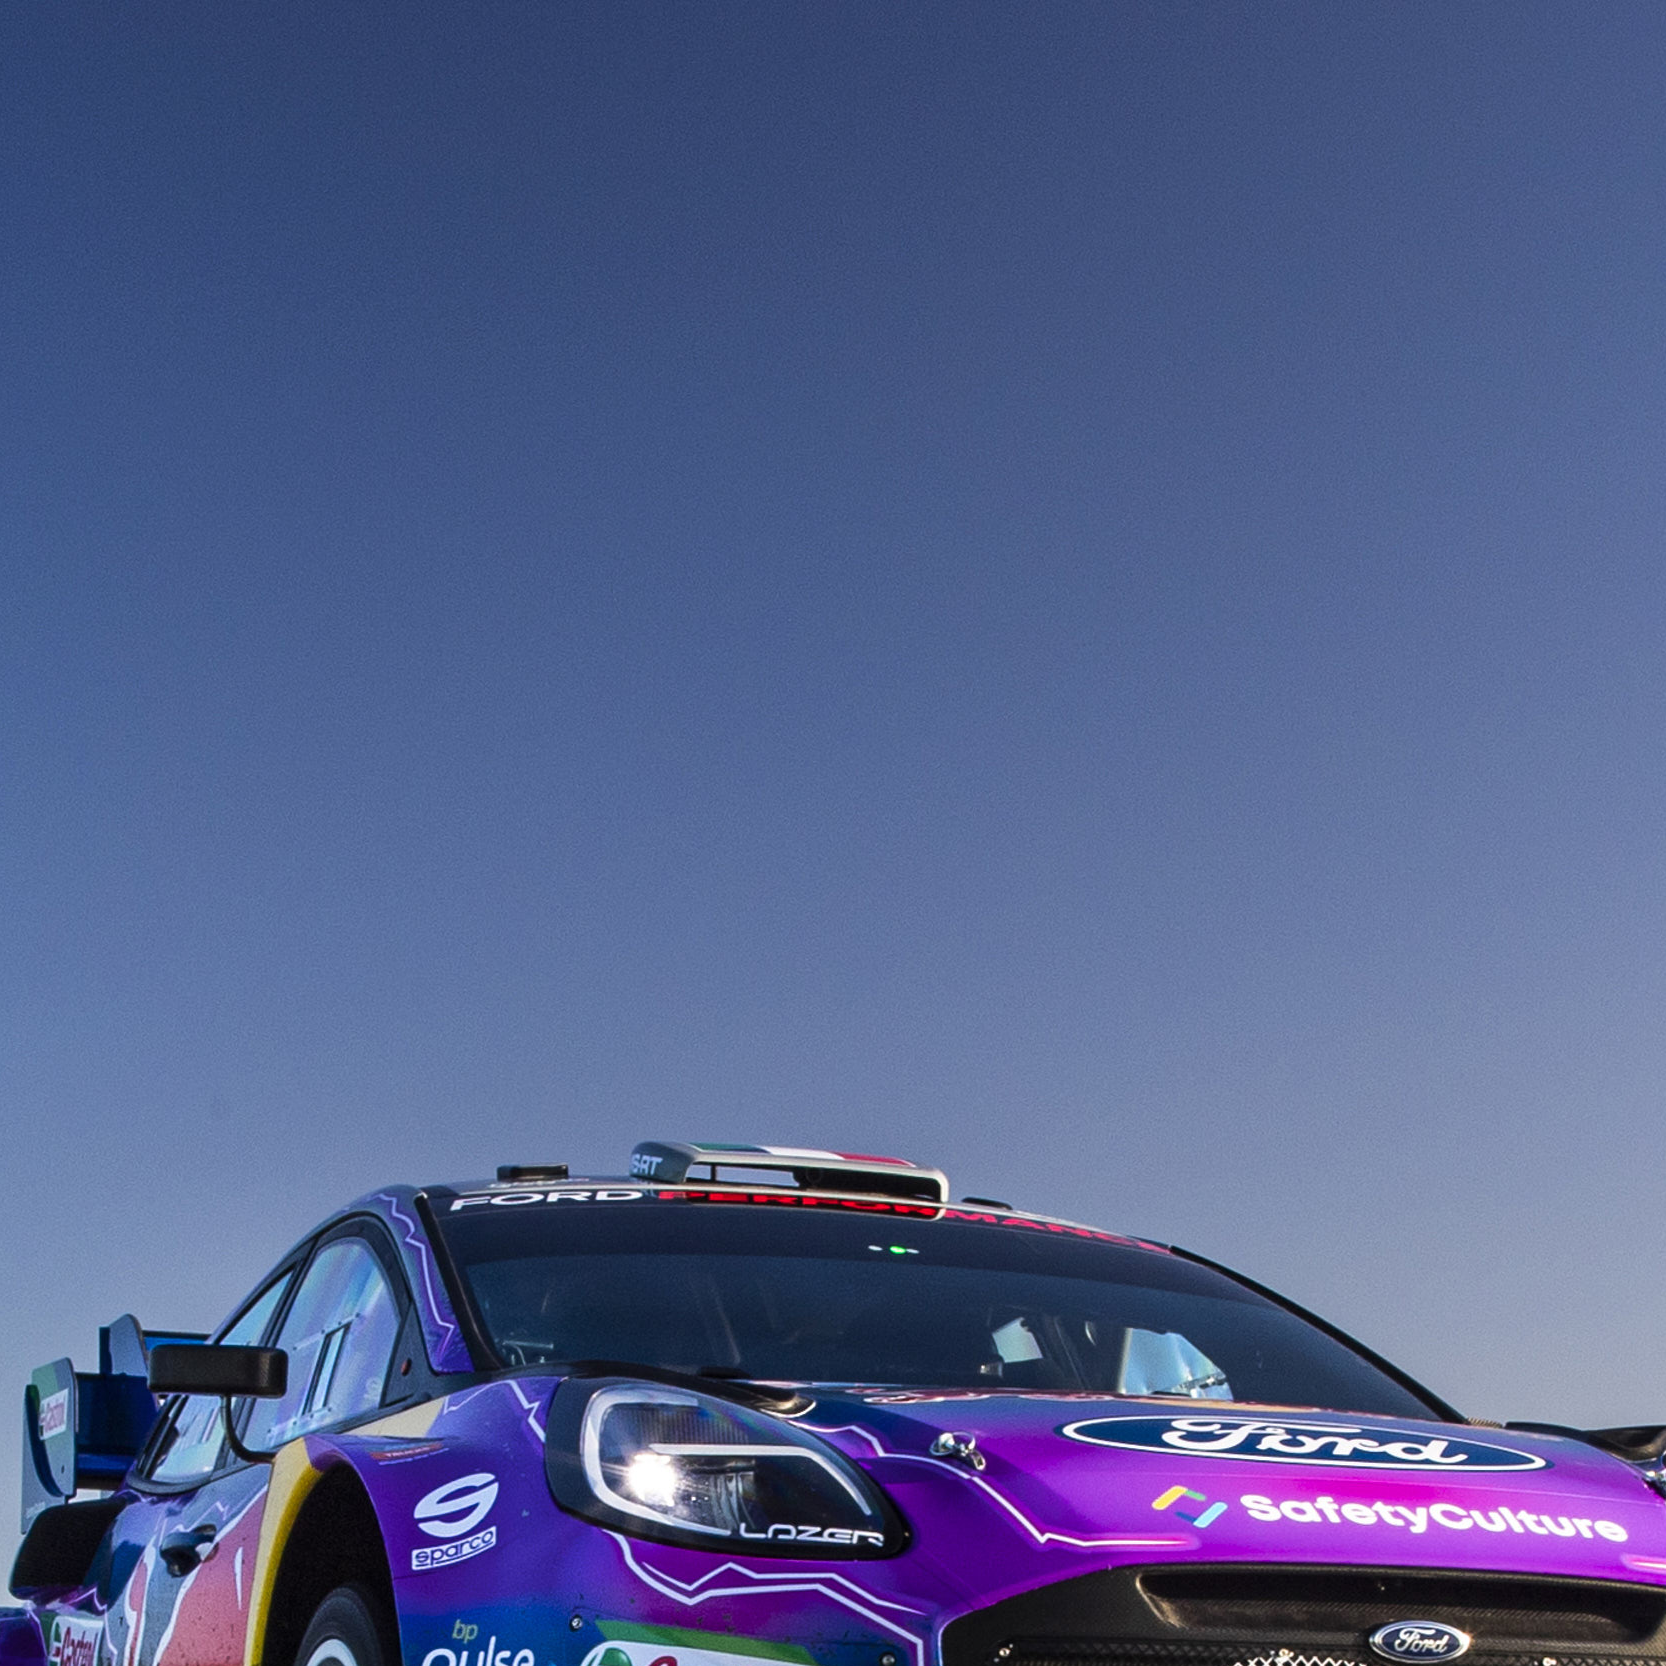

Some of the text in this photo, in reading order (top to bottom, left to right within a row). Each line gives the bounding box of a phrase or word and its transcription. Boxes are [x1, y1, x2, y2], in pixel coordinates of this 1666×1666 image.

[450, 1190, 643, 1211] FORD
[1161, 1418, 1469, 1464] Ford
[1239, 1494, 1629, 1543] SafetyCulture
[739, 1522, 884, 1547] LAZER
[414, 1530, 495, 1567] sparco
[451, 1618, 479, 1645] bp
[1394, 1627, 1450, 1653] Ford
